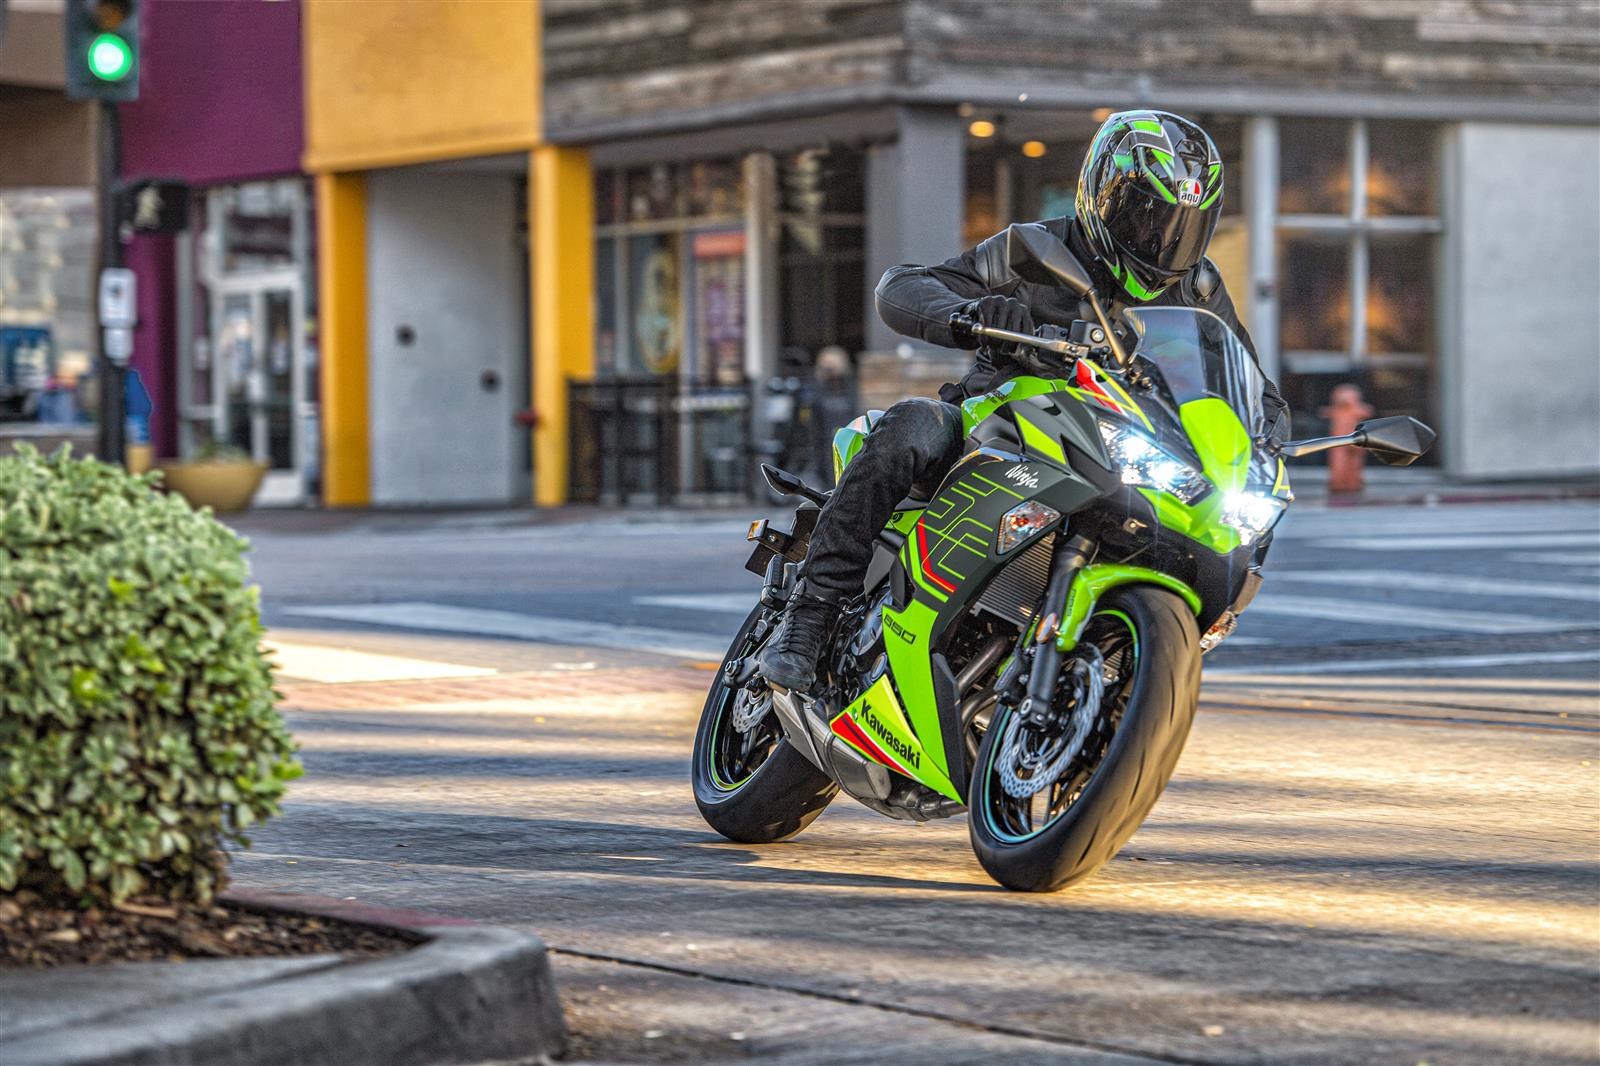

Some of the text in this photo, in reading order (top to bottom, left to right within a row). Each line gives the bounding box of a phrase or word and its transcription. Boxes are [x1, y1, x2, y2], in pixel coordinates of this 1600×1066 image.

[1004, 464, 1039, 489] Ninja
[884, 613, 917, 645] 650
[861, 698, 921, 770] Kawasaki
